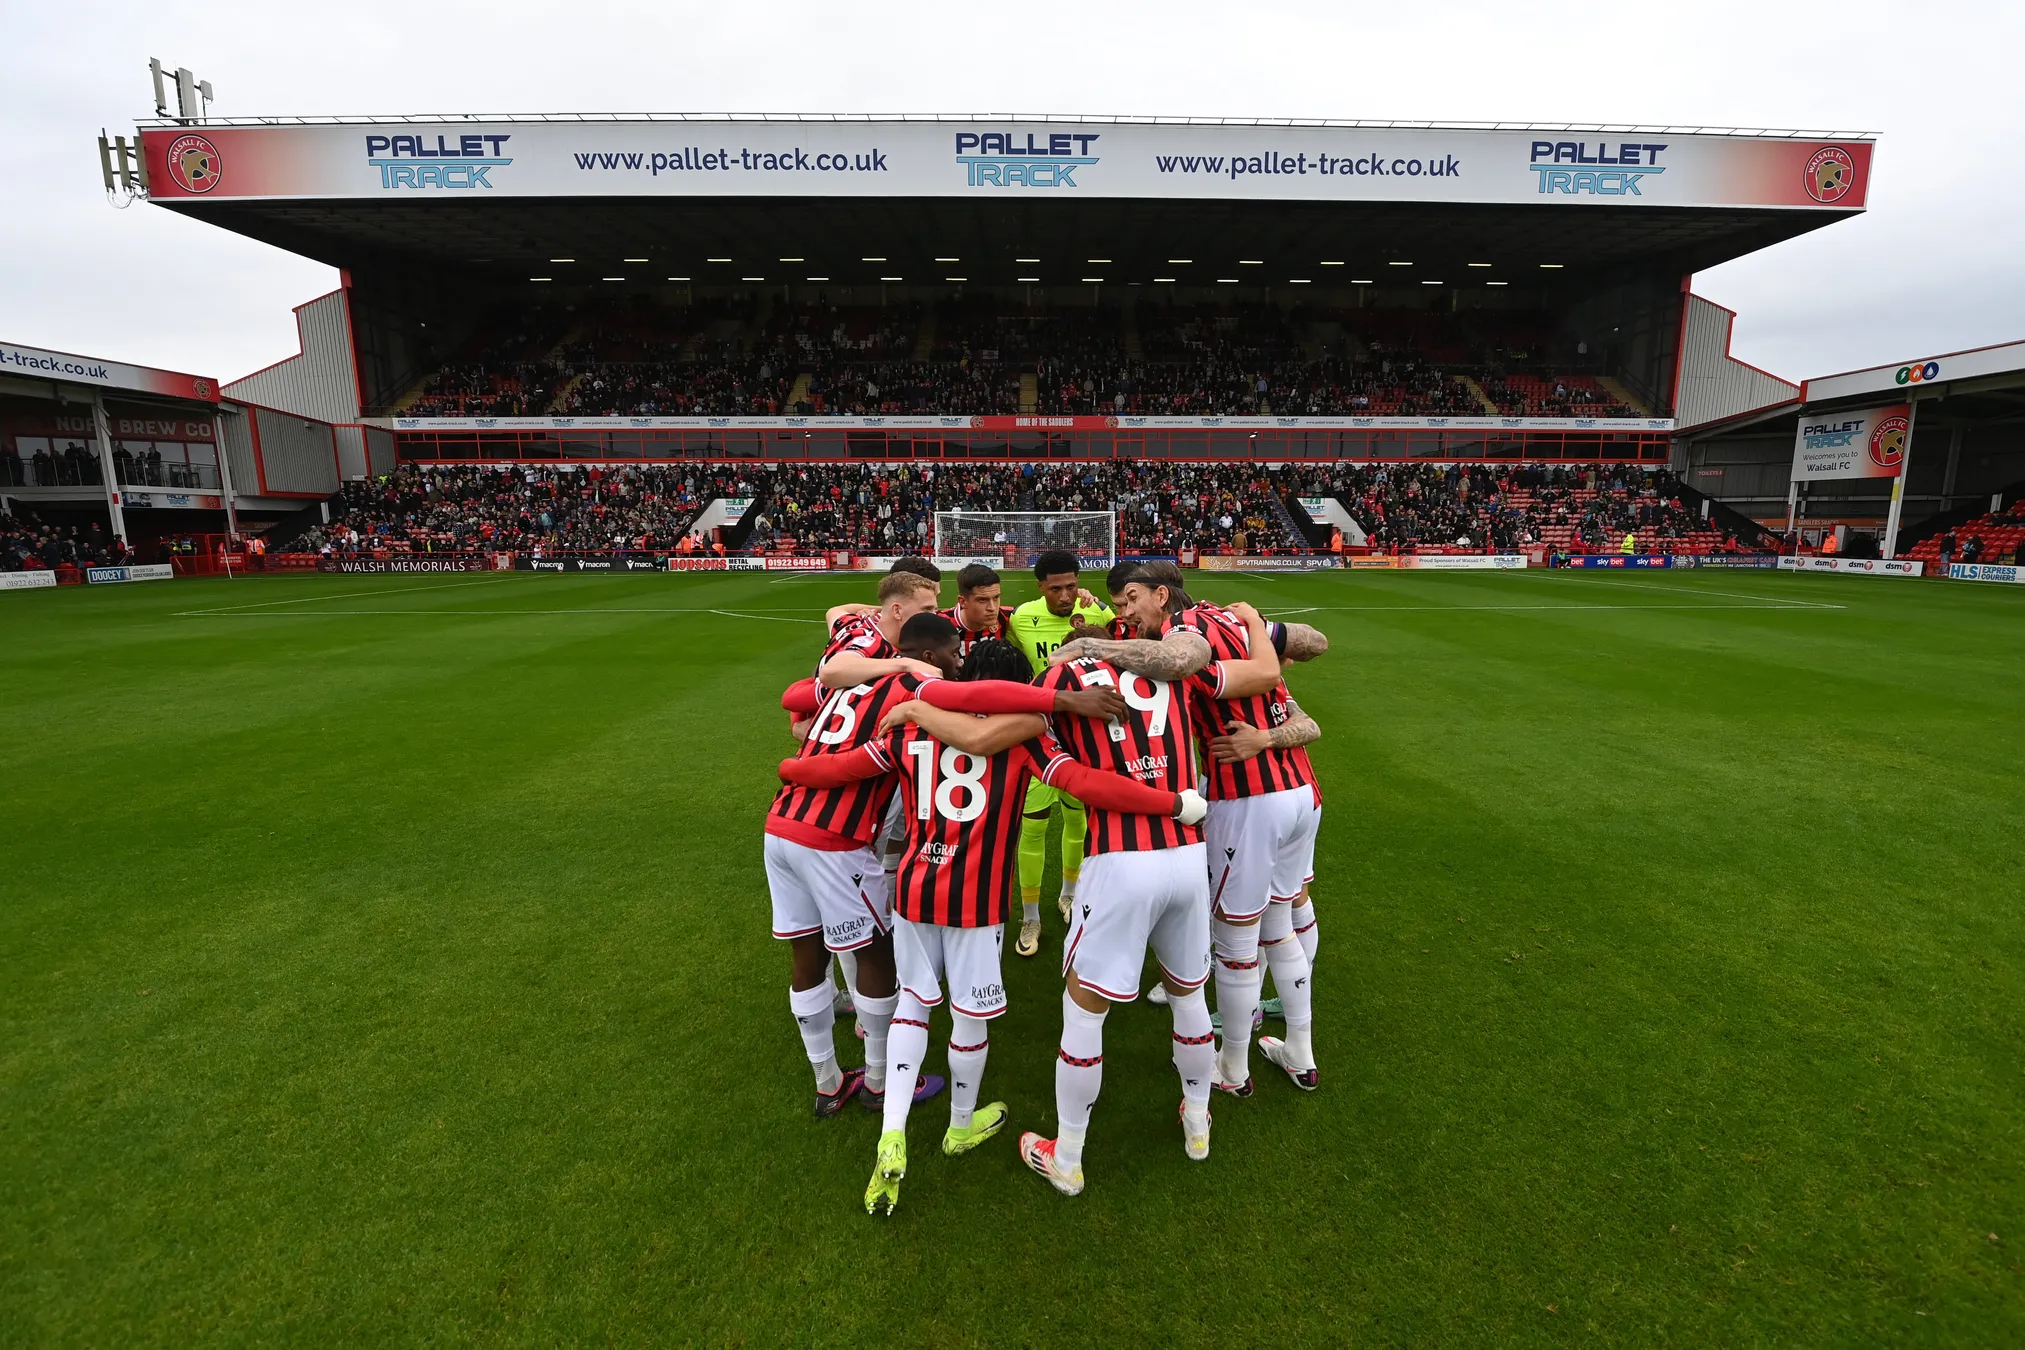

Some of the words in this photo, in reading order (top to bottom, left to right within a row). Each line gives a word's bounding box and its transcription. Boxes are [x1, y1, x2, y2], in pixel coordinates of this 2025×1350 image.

[171, 139, 195, 163] WALSALL
[196, 140, 206, 149] FC
[366, 135, 511, 157] PALLET
[956, 133, 1100, 155] PALLET
[573, 147, 888, 176] www.pallet-track.co.uk
[1530, 141, 1668, 165] PALLET
[1155, 151, 1460, 179] www.pallet-track.co.uk
[1808, 151, 1835, 173] WALSALL
[1835, 152, 1845, 161] FC
[369, 158, 513, 189] TRACK
[956, 156, 1100, 188] TRACK
[1530, 164, 1666, 195] TRACK
[0, 349, 108, 379] t-track.co.uk
[55, 416, 112, 433] NOR
[119, 419, 177, 435] BREW
[185, 422, 212, 437] CO
[1804, 420, 1865, 436] PALLET
[1873, 421, 1897, 442] WALSALL
[1803, 431, 1864, 449] TRACK
[1803, 453, 1836, 461] Welcomes
[1807, 463, 1837, 472] Walsall
[1839, 462, 1851, 470] FC
[341, 562, 385, 572] WALSH
[391, 561, 465, 572] MEMORIALS
[669, 558, 727, 570] HODSONS
[768, 558, 792, 566] 01922
[793, 558, 809, 566] 649
[810, 558, 826, 566] 649
[1597, 558, 1609, 566] sky
[1637, 558, 1649, 566] sky
[92, 570, 122, 581] DOOCEY
[1950, 565, 1978, 579] HLS
[1982, 567, 2017, 575] EXPRESS
[808, 684, 874, 745] 15
[1125, 755, 1168, 772] RAYGRAY
[908, 740, 987, 822] 18
[1135, 769, 1164, 781] SNACKS
[920, 842, 959, 856] AYGRAY
[920, 854, 949, 865] SNACKS
[826, 917, 866, 936] RAYGRAY
[833, 930, 861, 943] SNACKS
[976, 996, 1002, 1008] SNACKS
